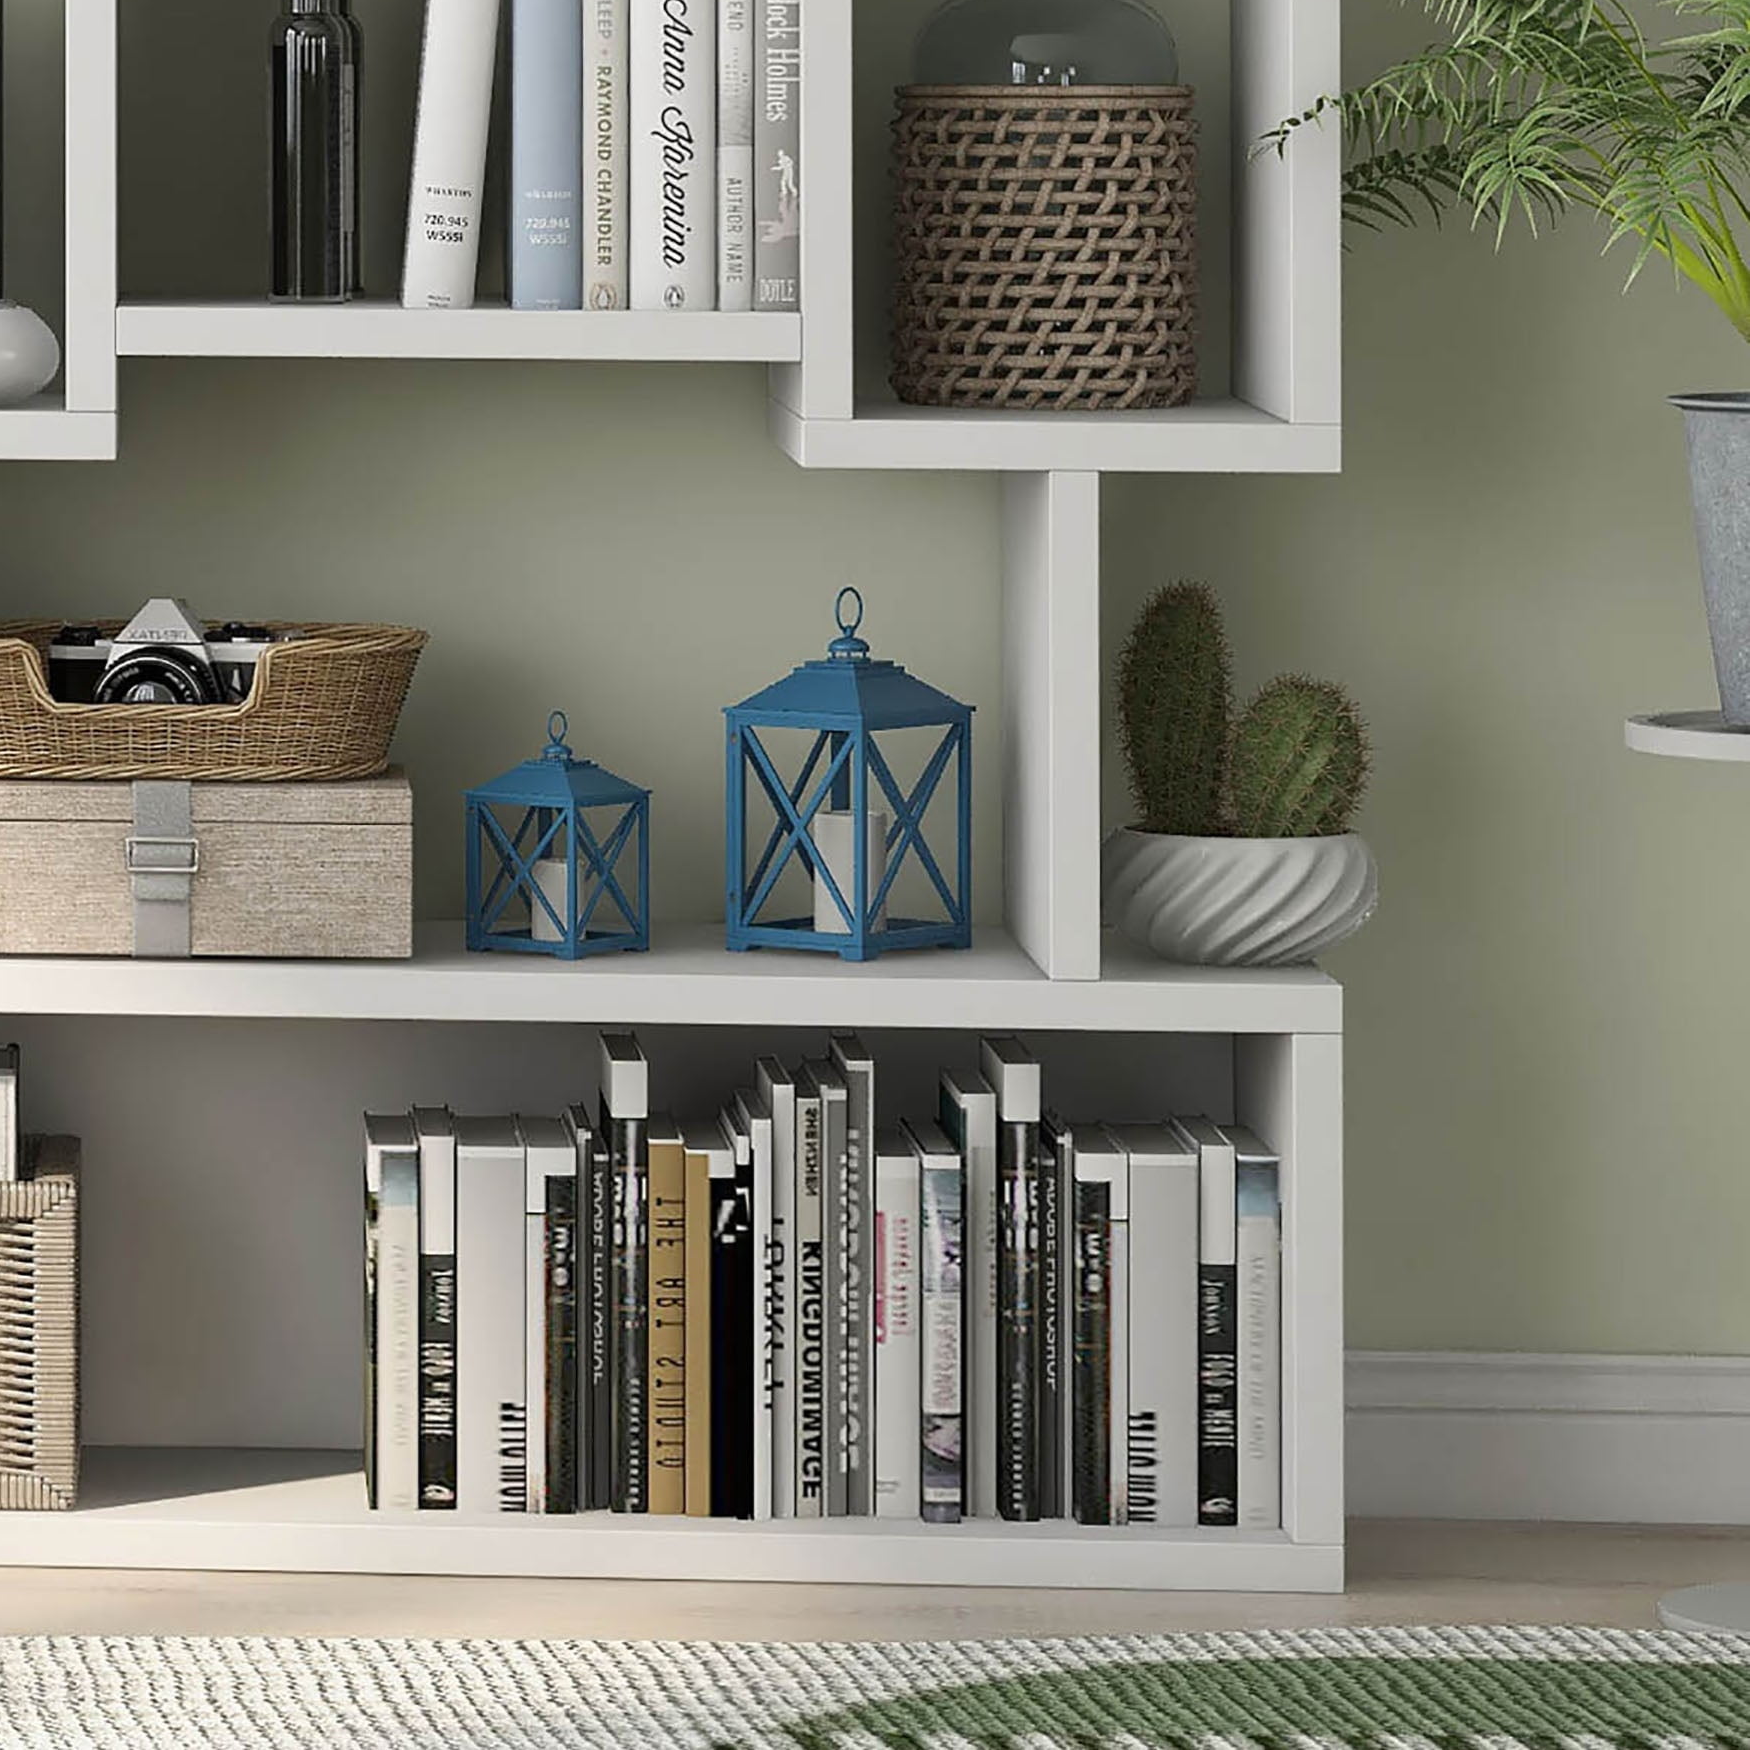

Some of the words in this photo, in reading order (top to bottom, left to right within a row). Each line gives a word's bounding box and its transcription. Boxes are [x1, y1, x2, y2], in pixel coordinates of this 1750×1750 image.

[727, 0, 744, 31] END
[597, 66, 612, 161] RAYMOND
[766, 48, 799, 122] Holmes
[597, 164, 612, 266] CHANDLER
[652, 107, 693, 267] Karenina
[725, 178, 742, 233] AUTHOR
[725, 243, 742, 283] NAME
